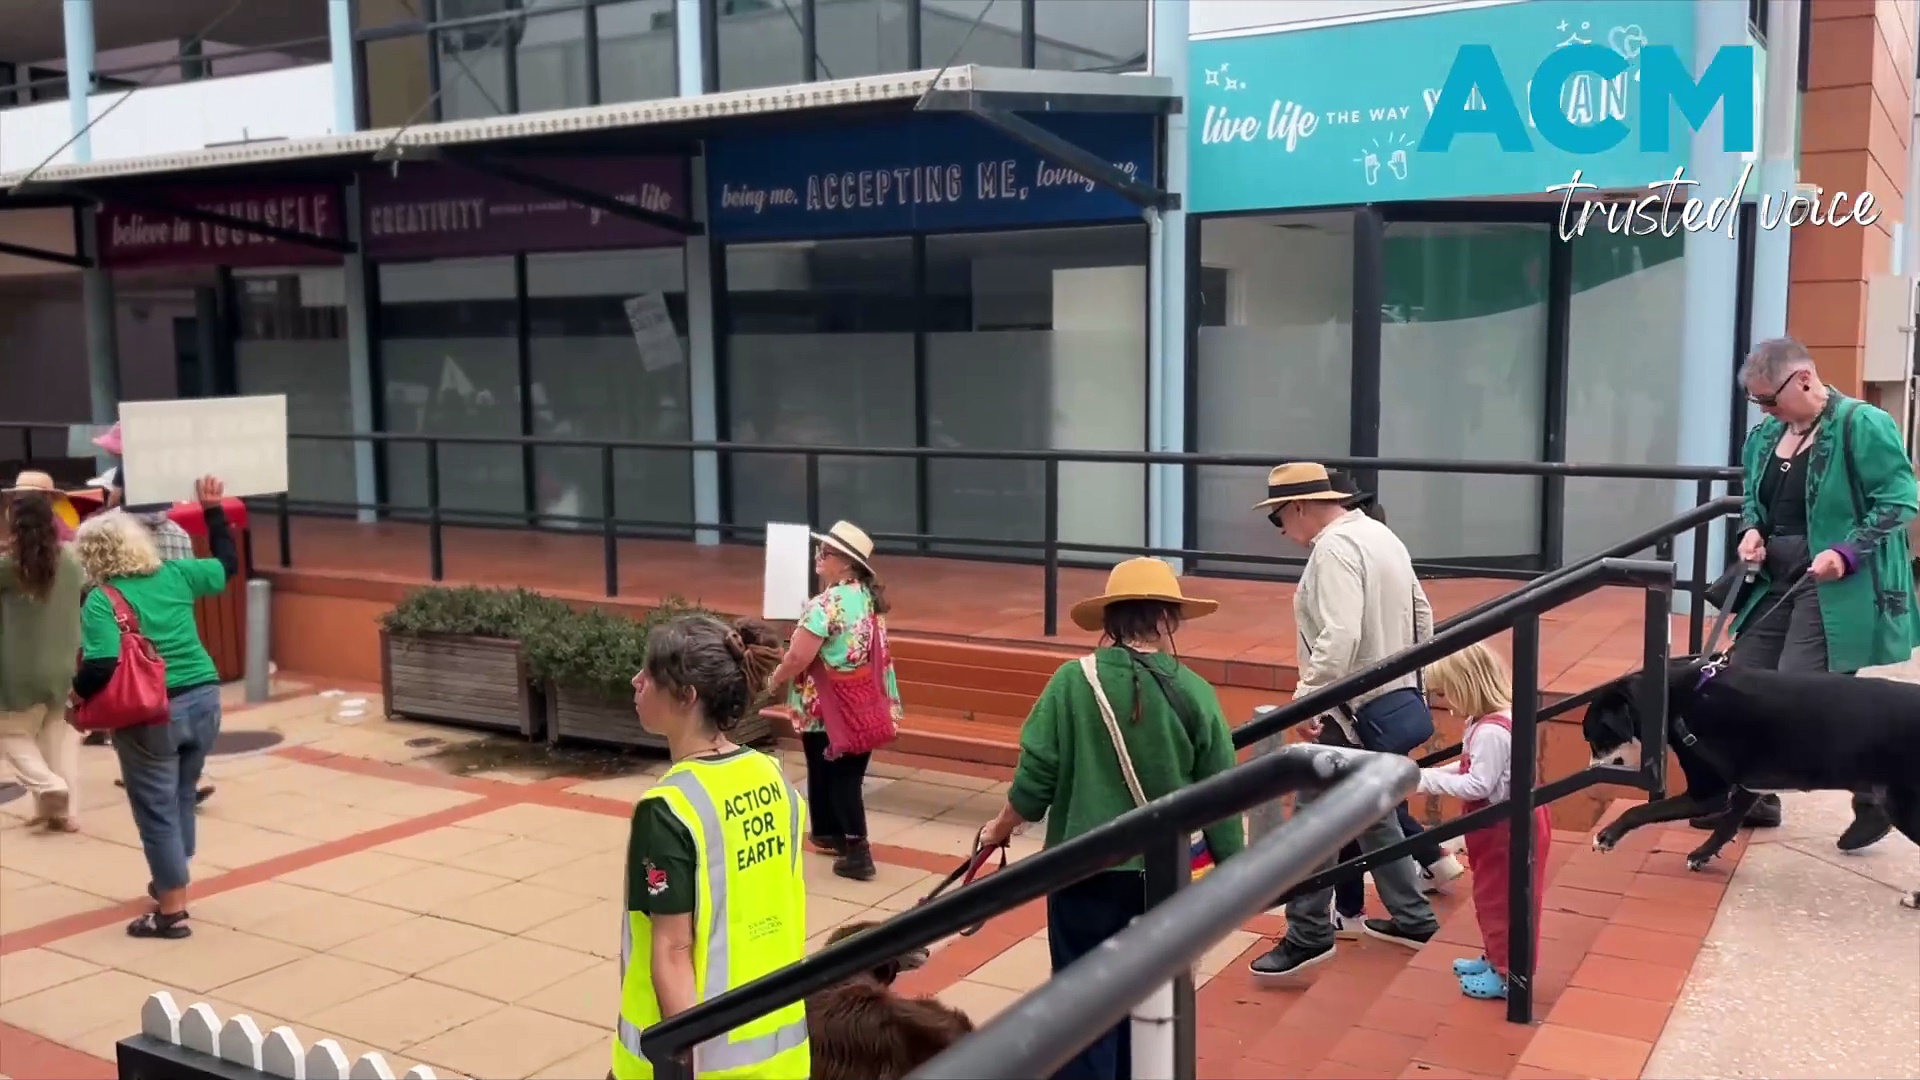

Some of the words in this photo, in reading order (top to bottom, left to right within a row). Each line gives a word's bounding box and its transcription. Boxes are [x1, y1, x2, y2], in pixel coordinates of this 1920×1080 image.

[1202, 103, 1262, 146] live
[1267, 99, 1321, 153] life
[1327, 112, 1361, 125] THE
[1369, 105, 1411, 121] WAY
[722, 184, 766, 214] being
[806, 163, 962, 211] ACCEPTING
[977, 159, 1029, 200] ME,
[1037, 159, 1095, 193] loving
[112, 213, 169, 247] believe
[172, 216, 191, 244] in
[371, 198, 485, 236] CREATIVITY
[724, 781, 782, 821] ACTION
[743, 812, 775, 841] FOR
[737, 834, 786, 871] EARTH
